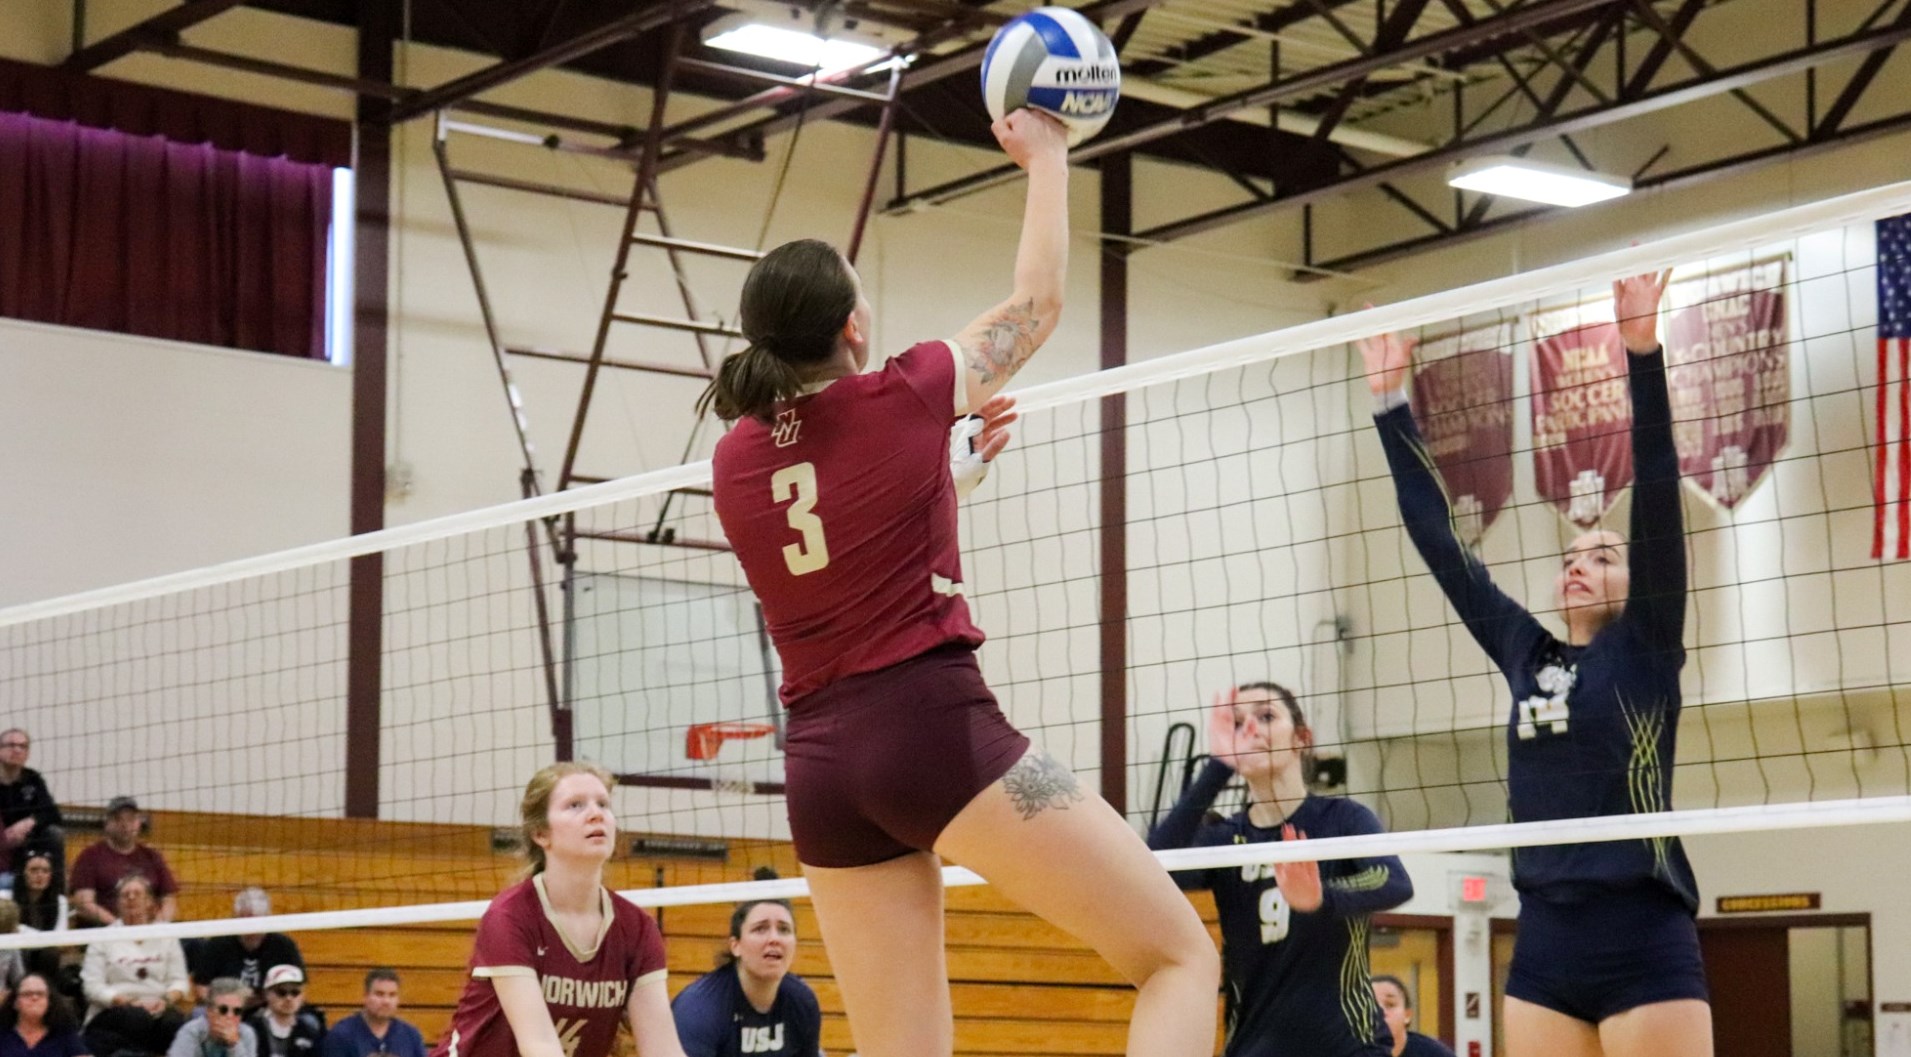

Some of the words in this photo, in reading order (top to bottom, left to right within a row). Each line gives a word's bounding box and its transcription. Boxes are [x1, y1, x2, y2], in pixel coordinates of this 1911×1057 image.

[1056, 66, 1117, 84] molten
[1551, 380, 1625, 412] SOCCER
[771, 461, 829, 576] 3
[1259, 887, 1290, 945] 9
[741, 1022, 784, 1053] USJ
